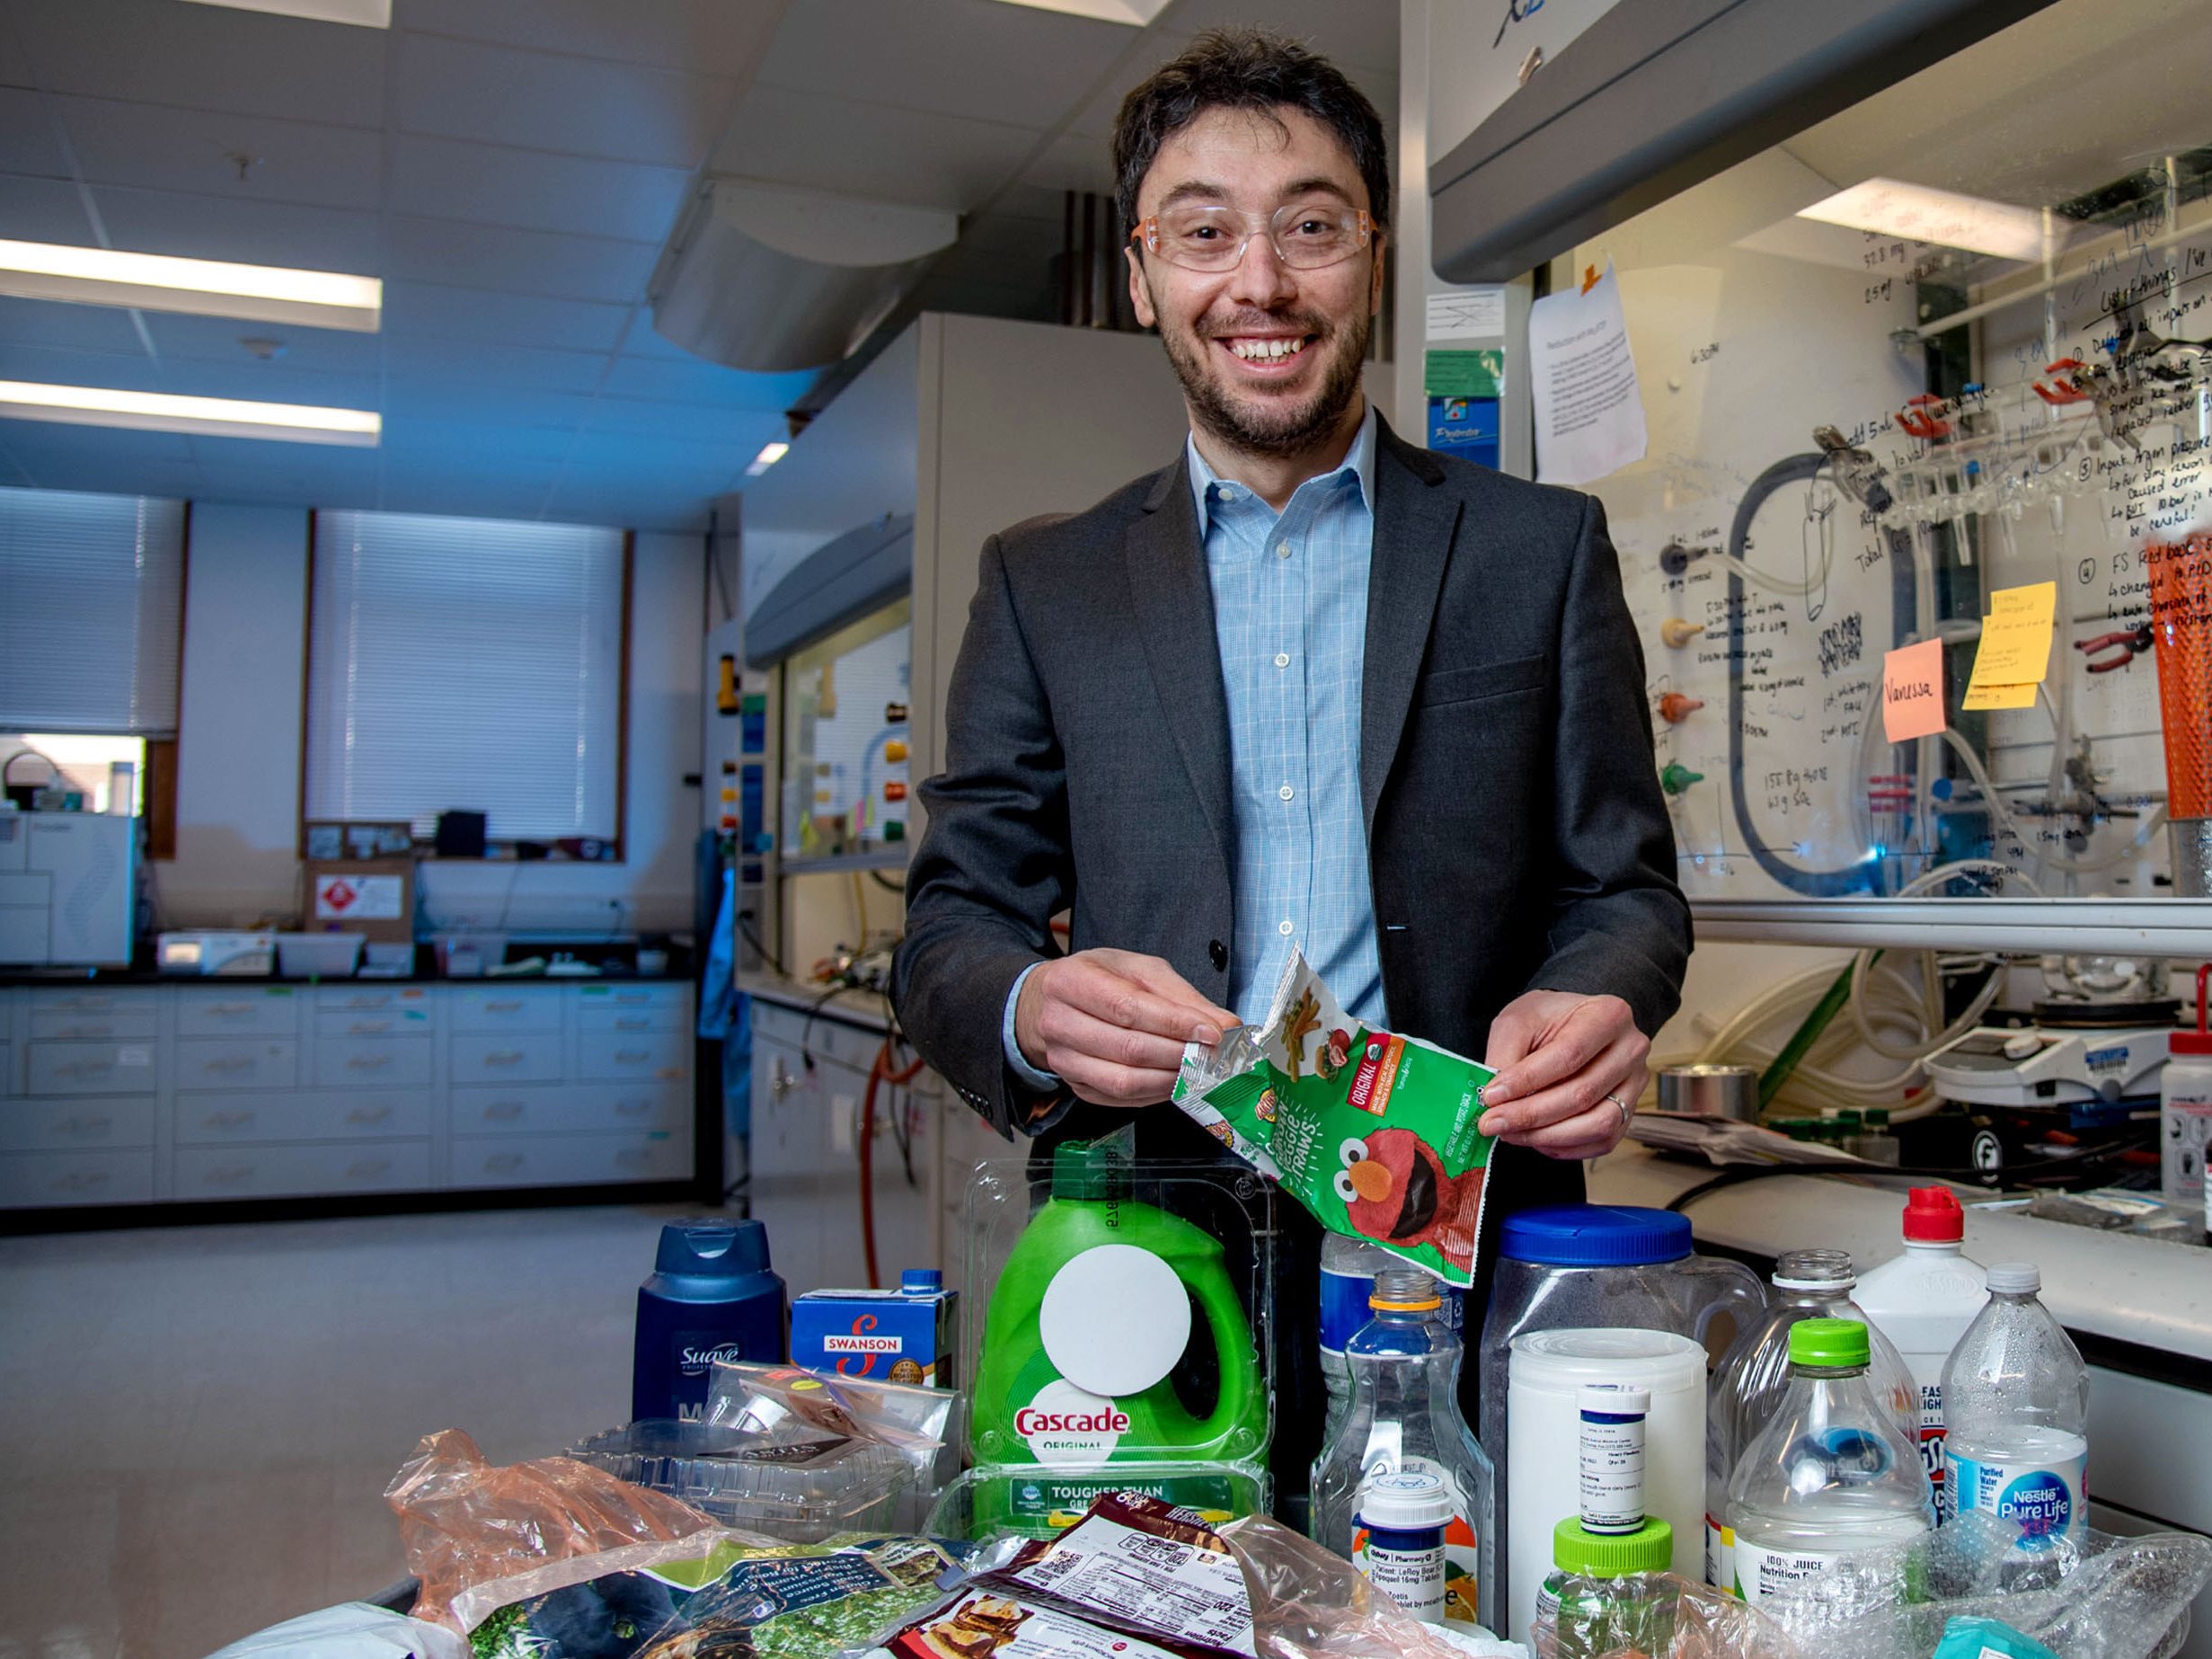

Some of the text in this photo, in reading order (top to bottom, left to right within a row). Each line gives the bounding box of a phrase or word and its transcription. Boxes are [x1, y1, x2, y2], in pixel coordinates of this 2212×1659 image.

[1885, 679, 1933, 704] Vanessa
[1351, 1062, 1376, 1105] ORIGINAL
[828, 1338, 898, 1351] SWANSON
[680, 1347, 739, 1363] Suave
[1924, 1398, 1941, 1409] IGH
[678, 1403, 702, 1423] M
[1016, 1406, 1128, 1435] Cascade
[1043, 1441, 1102, 1451] ORIGINAL
[1069, 1499, 1088, 1510] GRE
[2002, 1500, 2068, 1522] Pure Life
[1760, 1564, 1800, 1580] Nutrition
[1793, 1560, 1824, 1571] JUICE
[1213, 1601, 1236, 1612] 220
